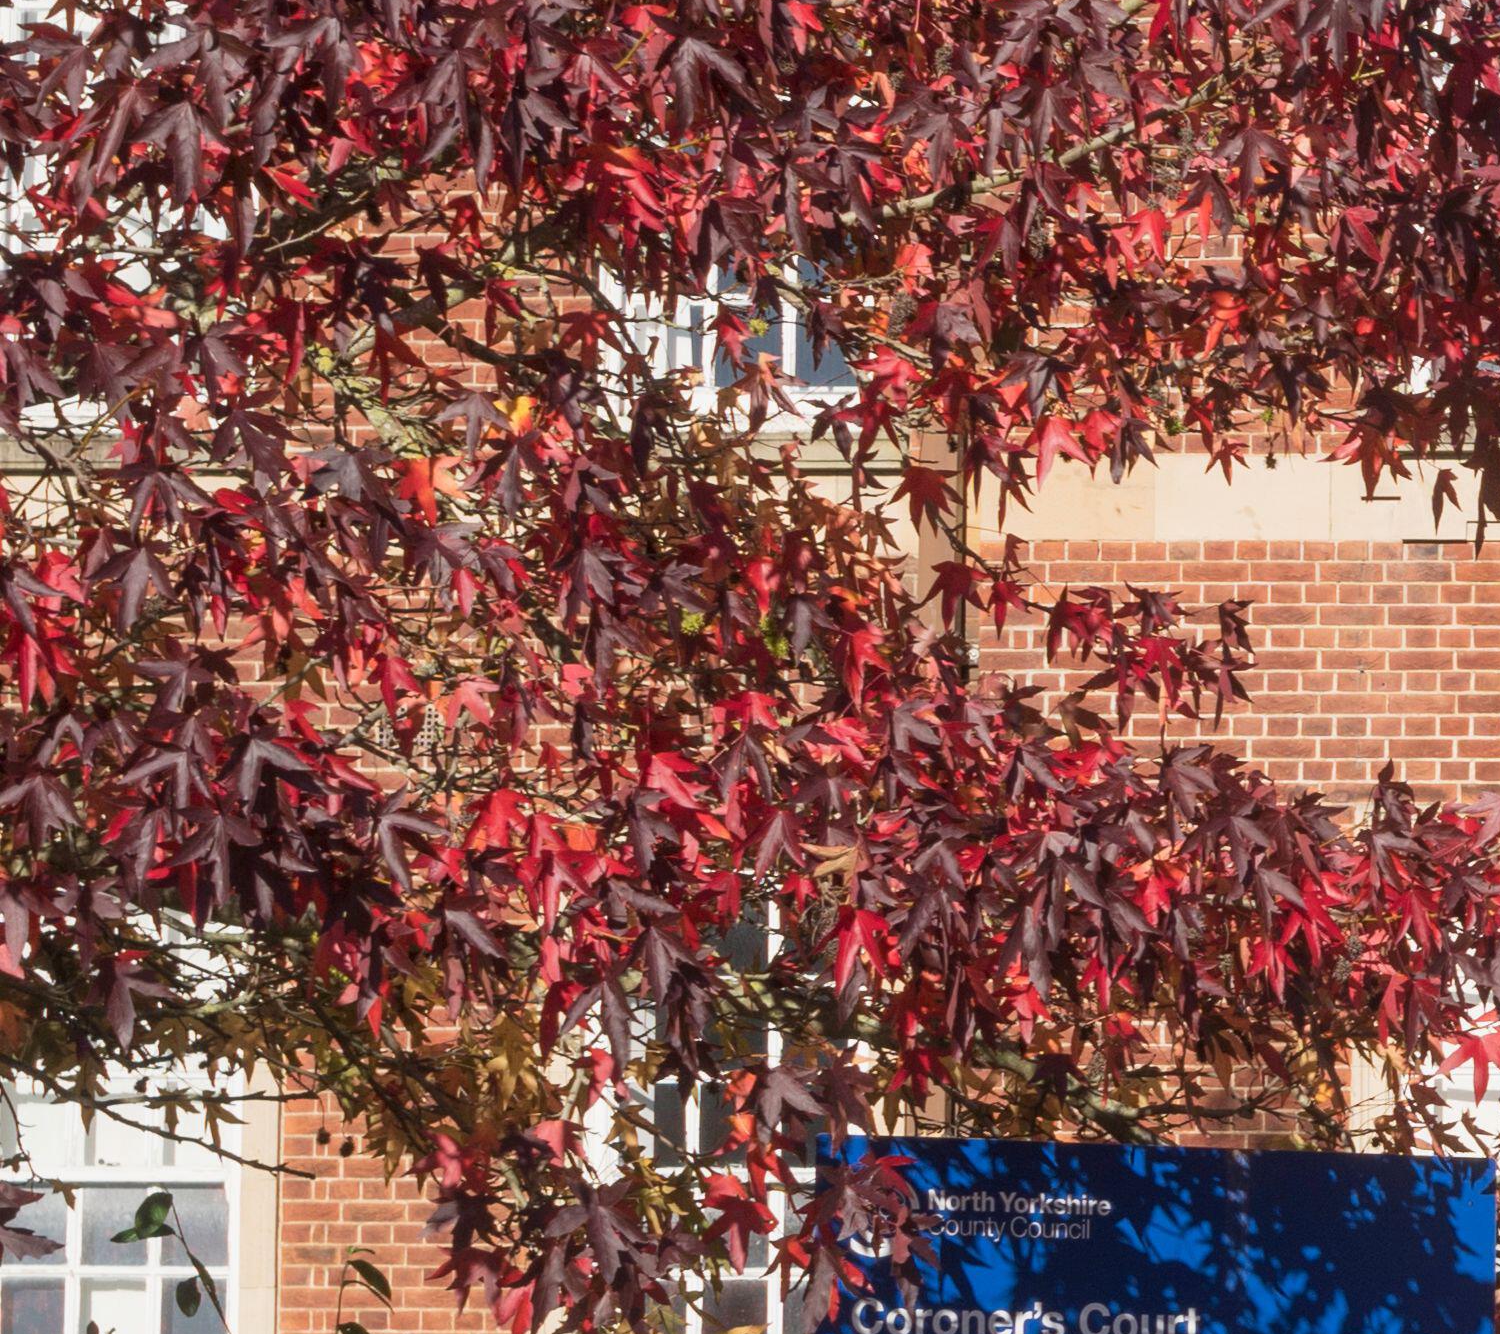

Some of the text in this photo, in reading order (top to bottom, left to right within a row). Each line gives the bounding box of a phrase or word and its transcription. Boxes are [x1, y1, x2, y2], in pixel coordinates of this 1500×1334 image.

[928, 1189, 1112, 1216] North Yorkshire
[1010, 1216, 1090, 1240] Council
